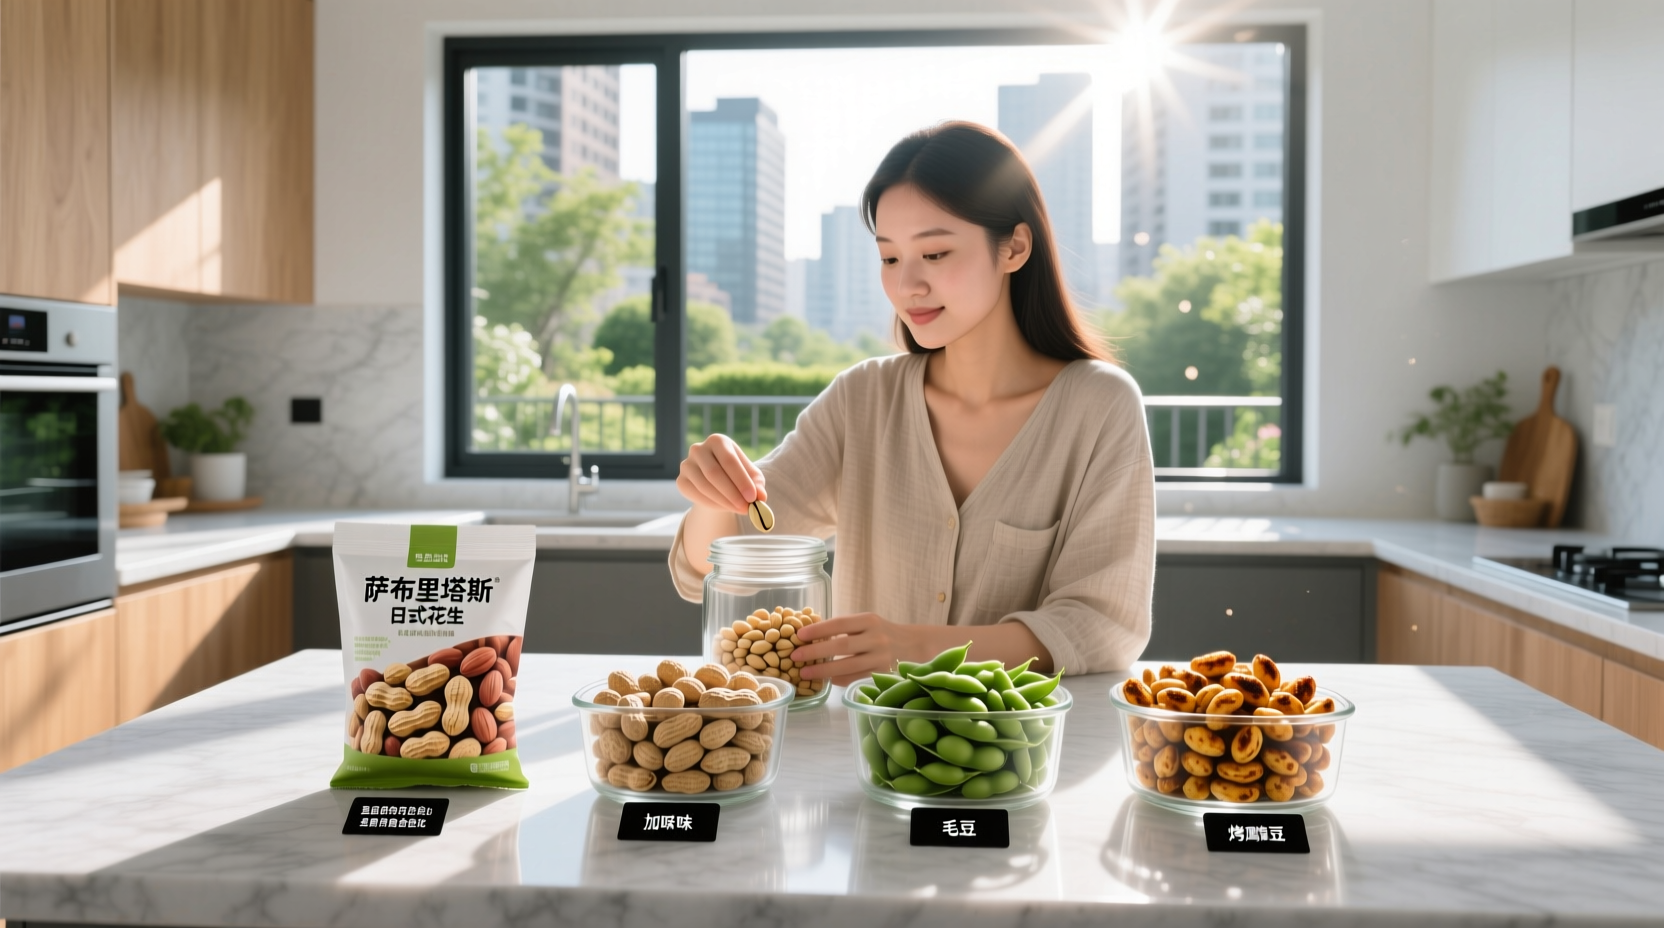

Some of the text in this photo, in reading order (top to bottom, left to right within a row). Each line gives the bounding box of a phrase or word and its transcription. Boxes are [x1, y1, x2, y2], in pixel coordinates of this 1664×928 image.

[364, 575, 494, 603] 萨布里塔斯
[391, 605, 464, 626] 日式花生
[942, 819, 977, 837] 毛豆
